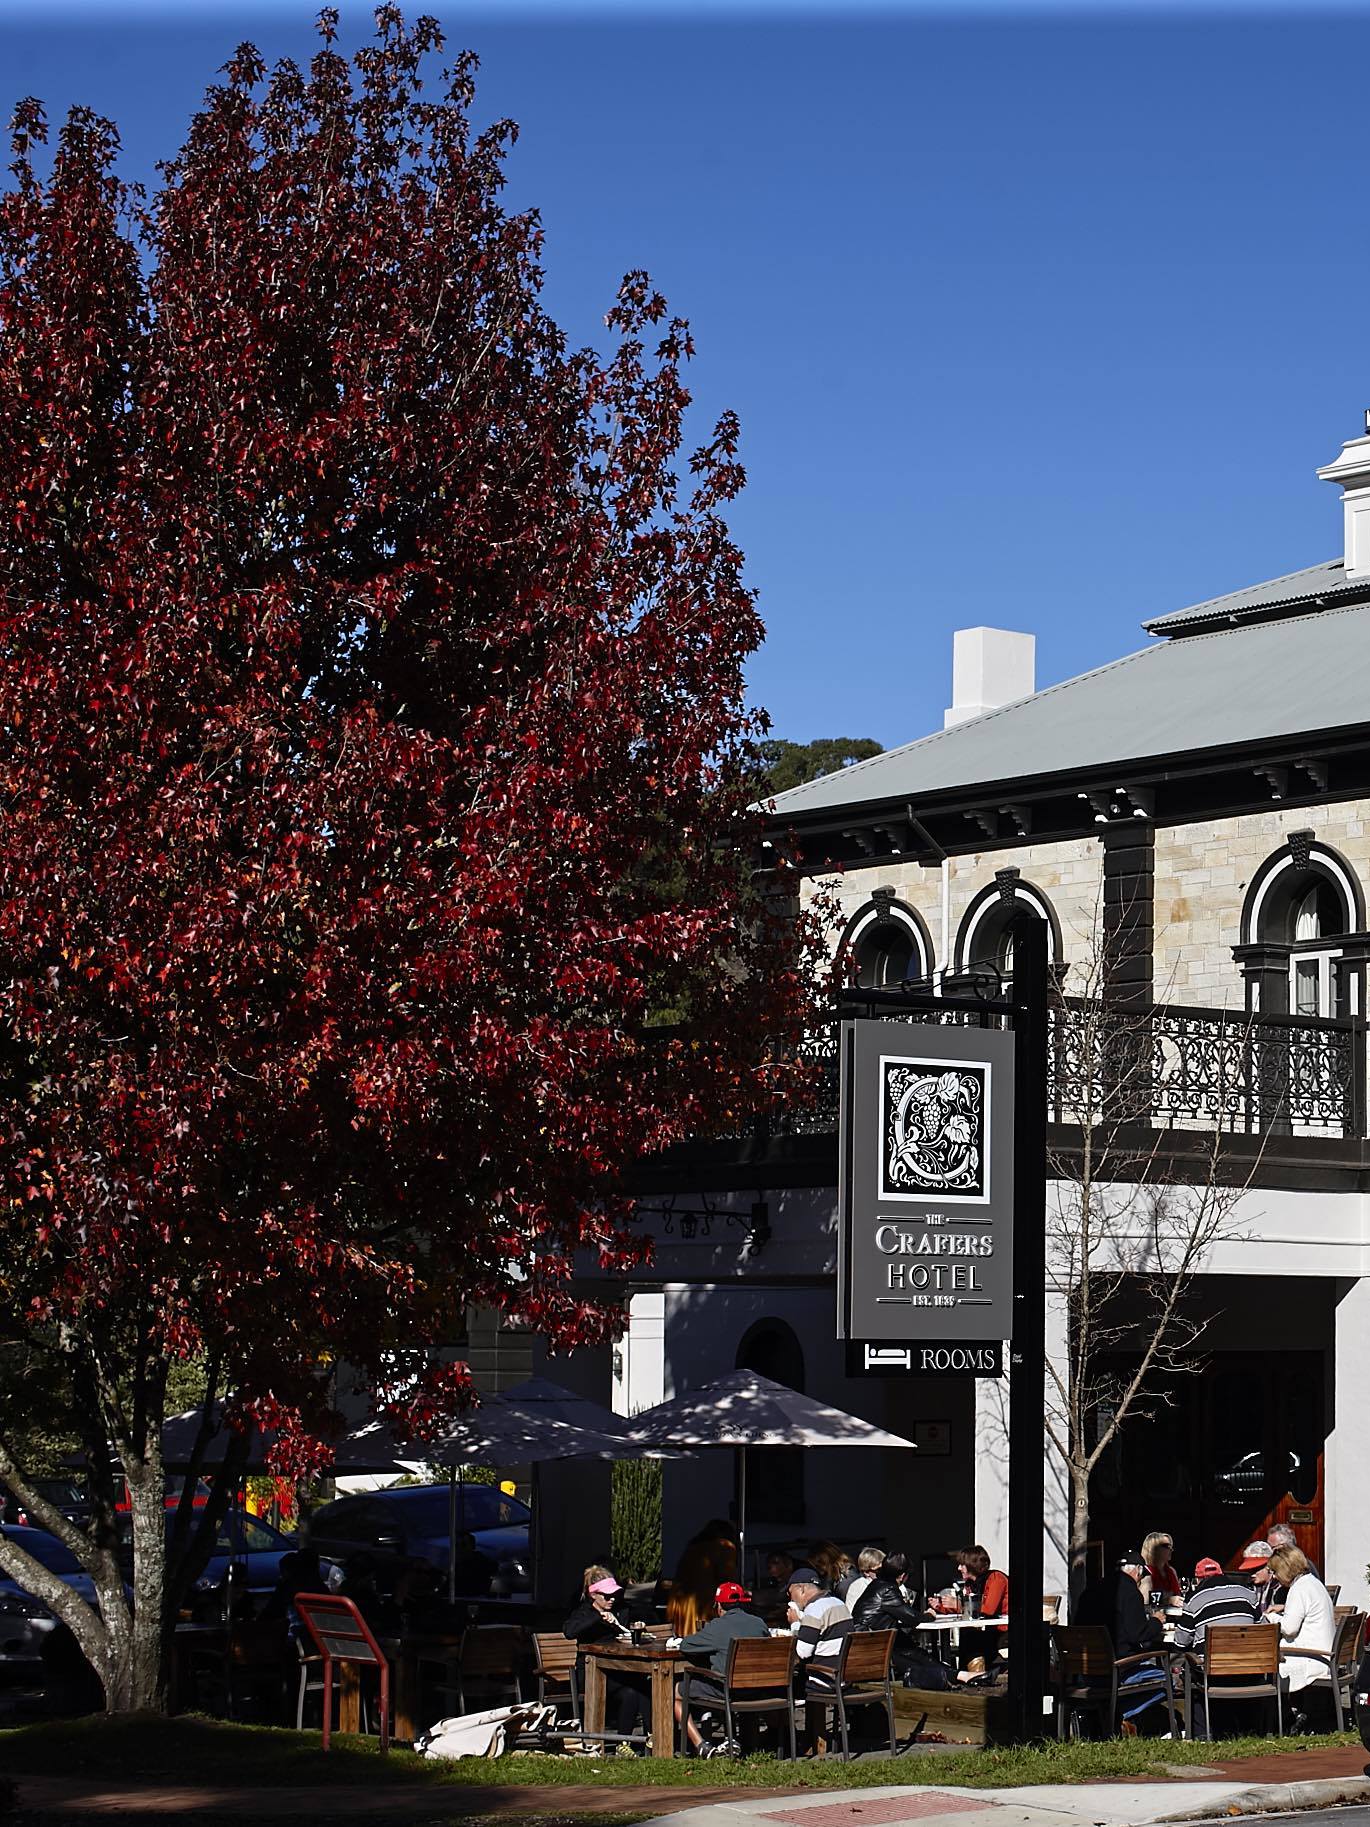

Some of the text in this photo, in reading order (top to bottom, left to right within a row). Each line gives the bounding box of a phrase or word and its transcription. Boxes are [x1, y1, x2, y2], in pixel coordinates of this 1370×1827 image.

[926, 1214, 945, 1225] THE
[876, 1225, 993, 1256] CRAFERS
[888, 1263, 982, 1290] HOTEL
[913, 1295, 932, 1306] EST.
[920, 1349, 995, 1370] ROOMS
[1151, 1592, 1162, 1604] 57
